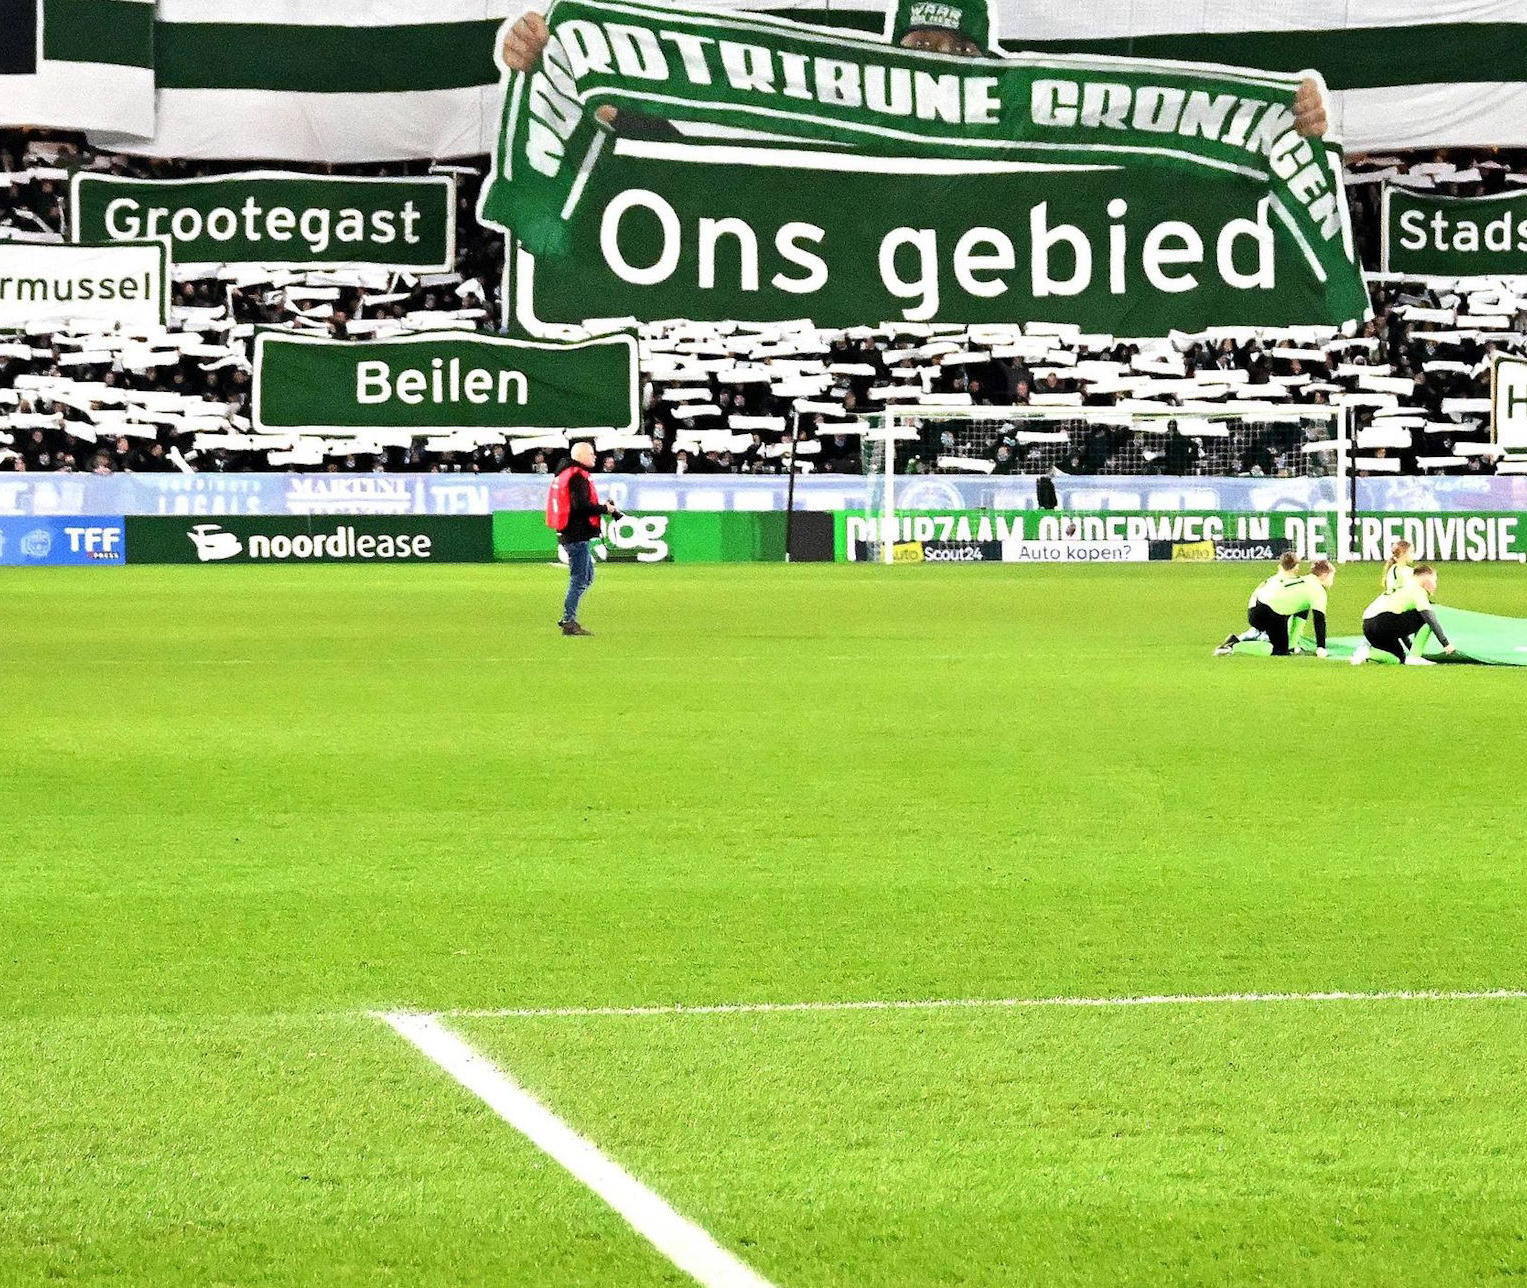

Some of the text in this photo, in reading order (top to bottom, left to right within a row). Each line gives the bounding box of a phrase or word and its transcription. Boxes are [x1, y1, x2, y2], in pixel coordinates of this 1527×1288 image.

[525, 19, 1342, 242] NOORDTRIBUNE GRONINGEN
[103, 195, 422, 253] Grootegast
[600, 188, 1275, 322] Ons gebied
[356, 356, 529, 406] Beilen
[64, 527, 121, 553] TFF
[248, 525, 432, 558] noordlease
[1018, 544, 1133, 562] Auto kopen?
[1284, 516, 1327, 561] DE
